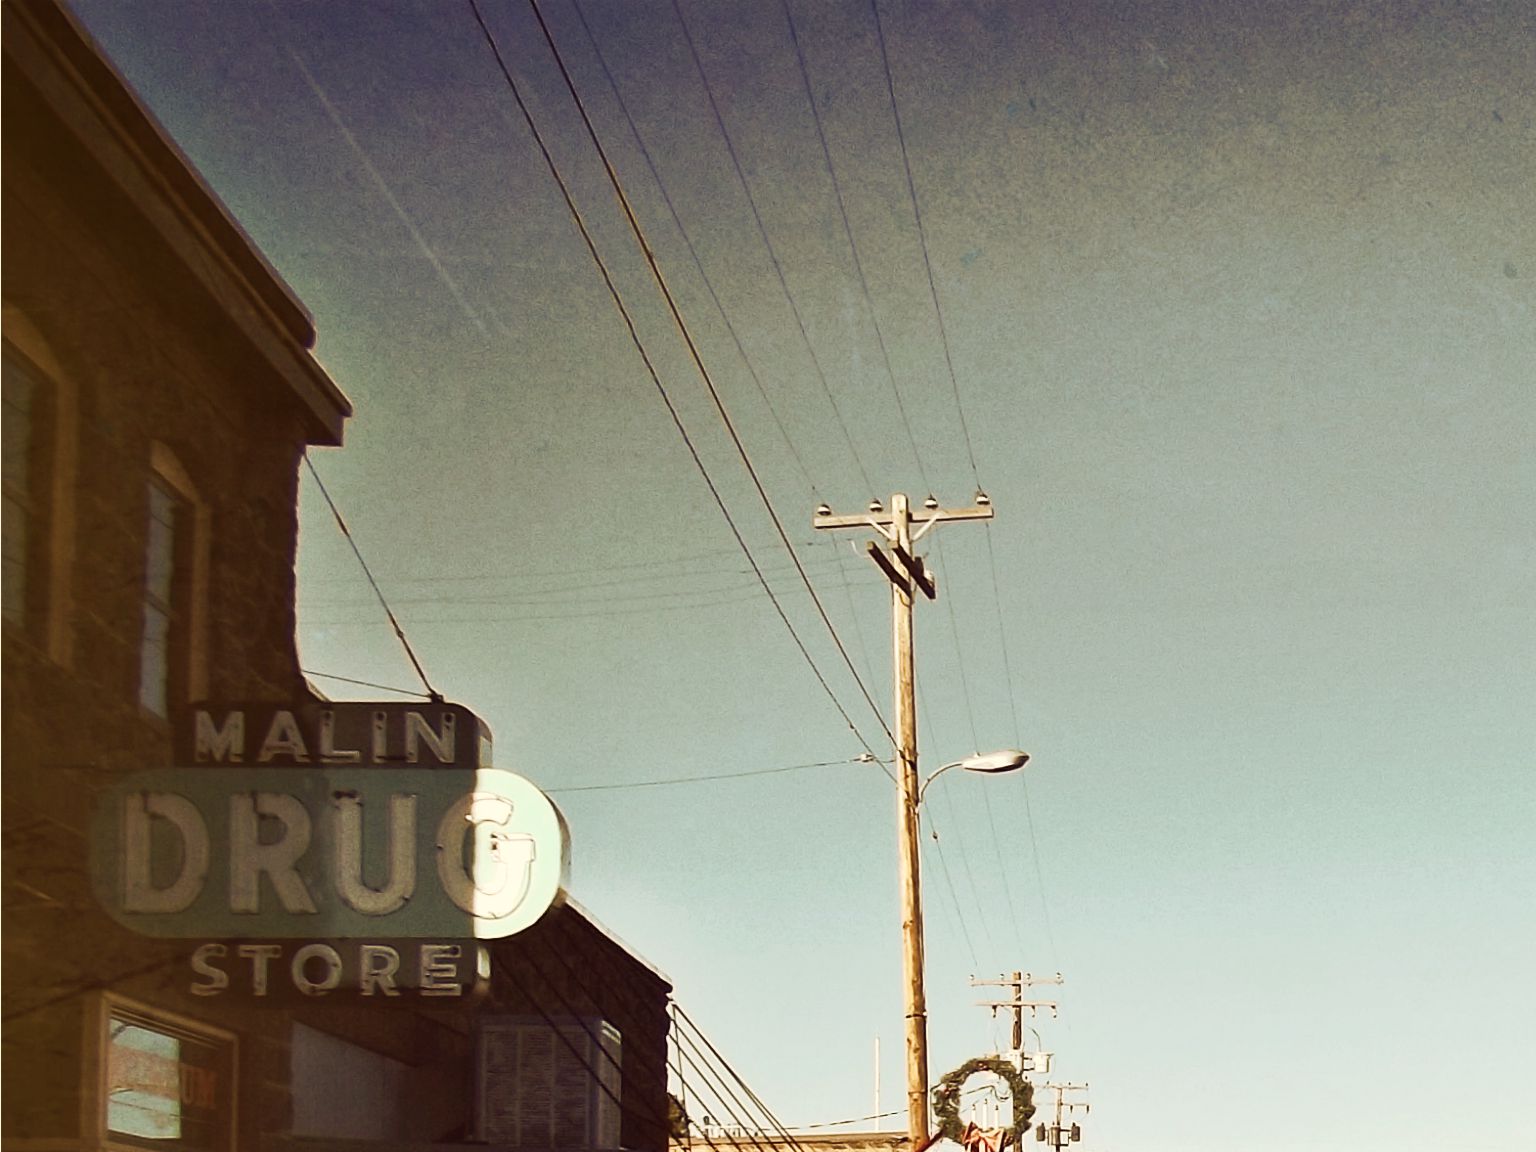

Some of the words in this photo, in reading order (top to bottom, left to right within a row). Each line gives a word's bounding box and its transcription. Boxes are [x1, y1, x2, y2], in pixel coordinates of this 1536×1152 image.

[195, 711, 456, 763] MALIN
[123, 791, 536, 919] DRUG
[190, 943, 462, 996] STORE
